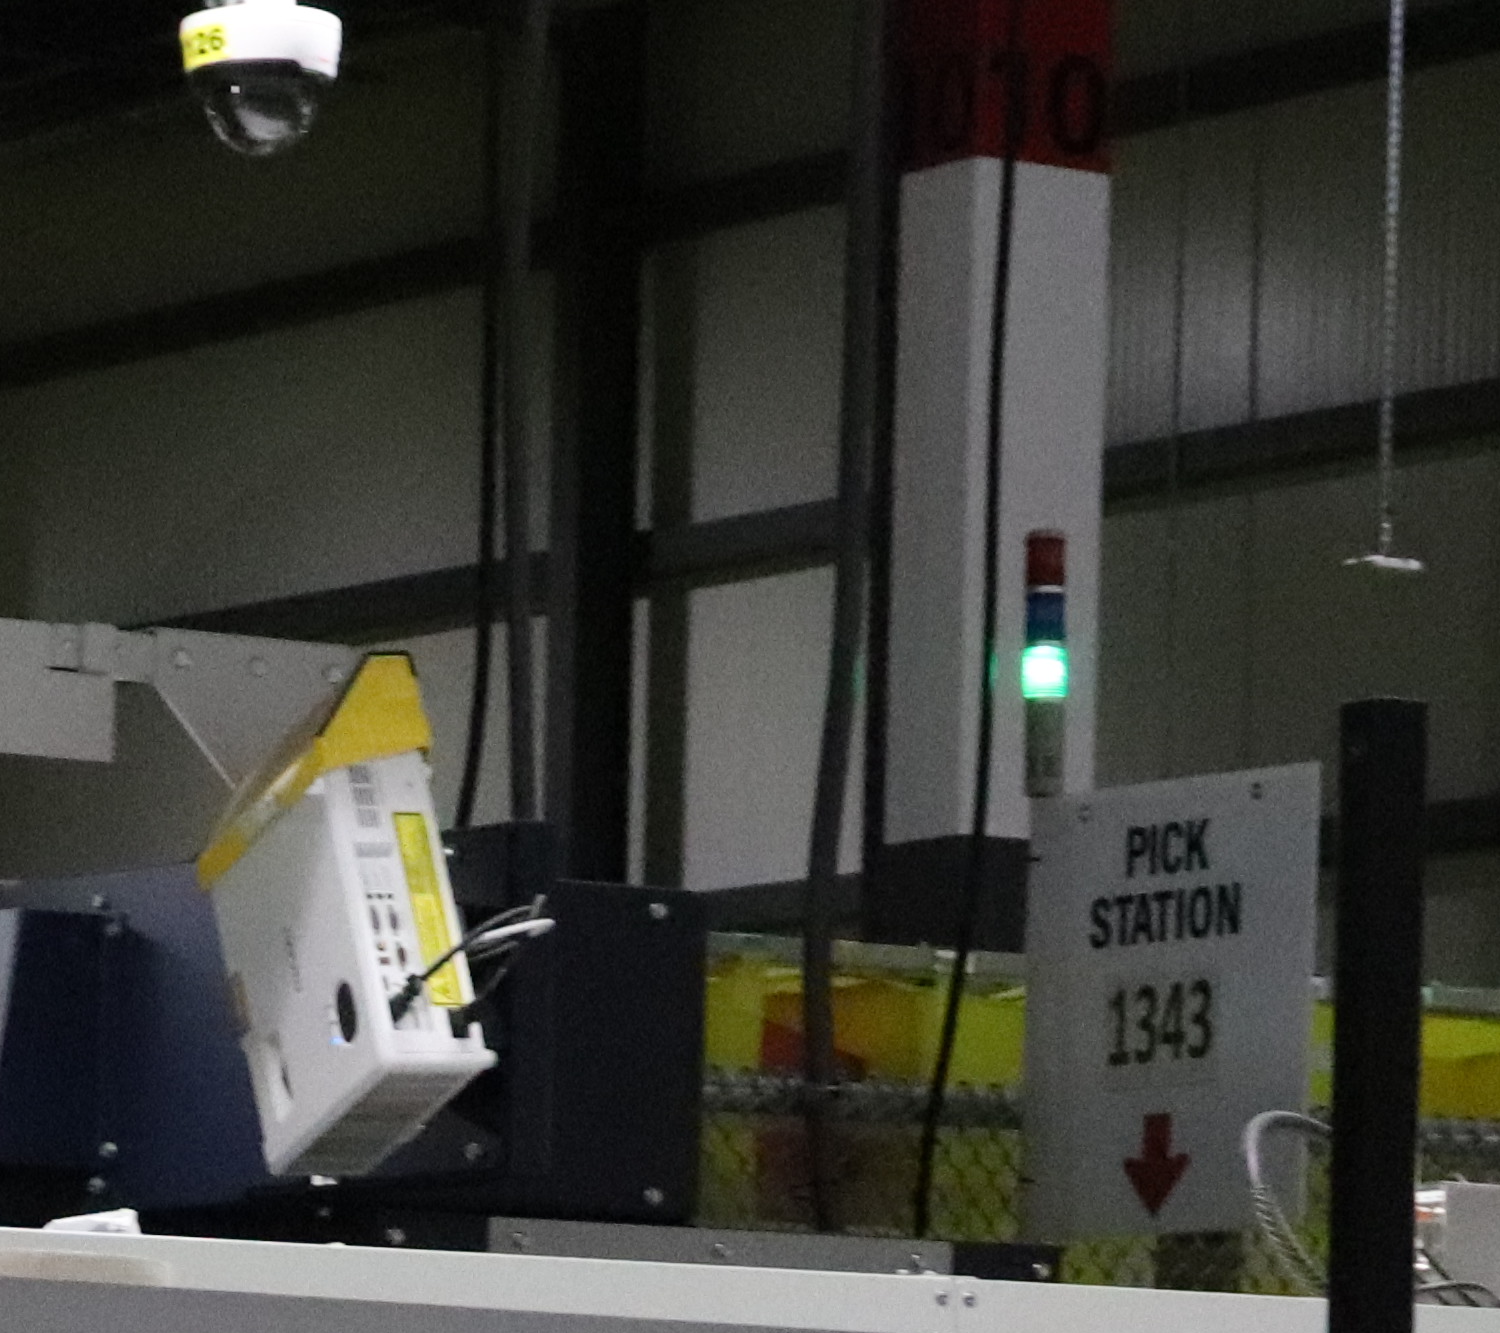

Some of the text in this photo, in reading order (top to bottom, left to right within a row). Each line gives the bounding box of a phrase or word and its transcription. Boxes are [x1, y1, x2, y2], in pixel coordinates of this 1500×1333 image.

[1124, 818, 1212, 879] PICK
[1088, 882, 1243, 950] STATION
[1105, 978, 1215, 1067] 1343
